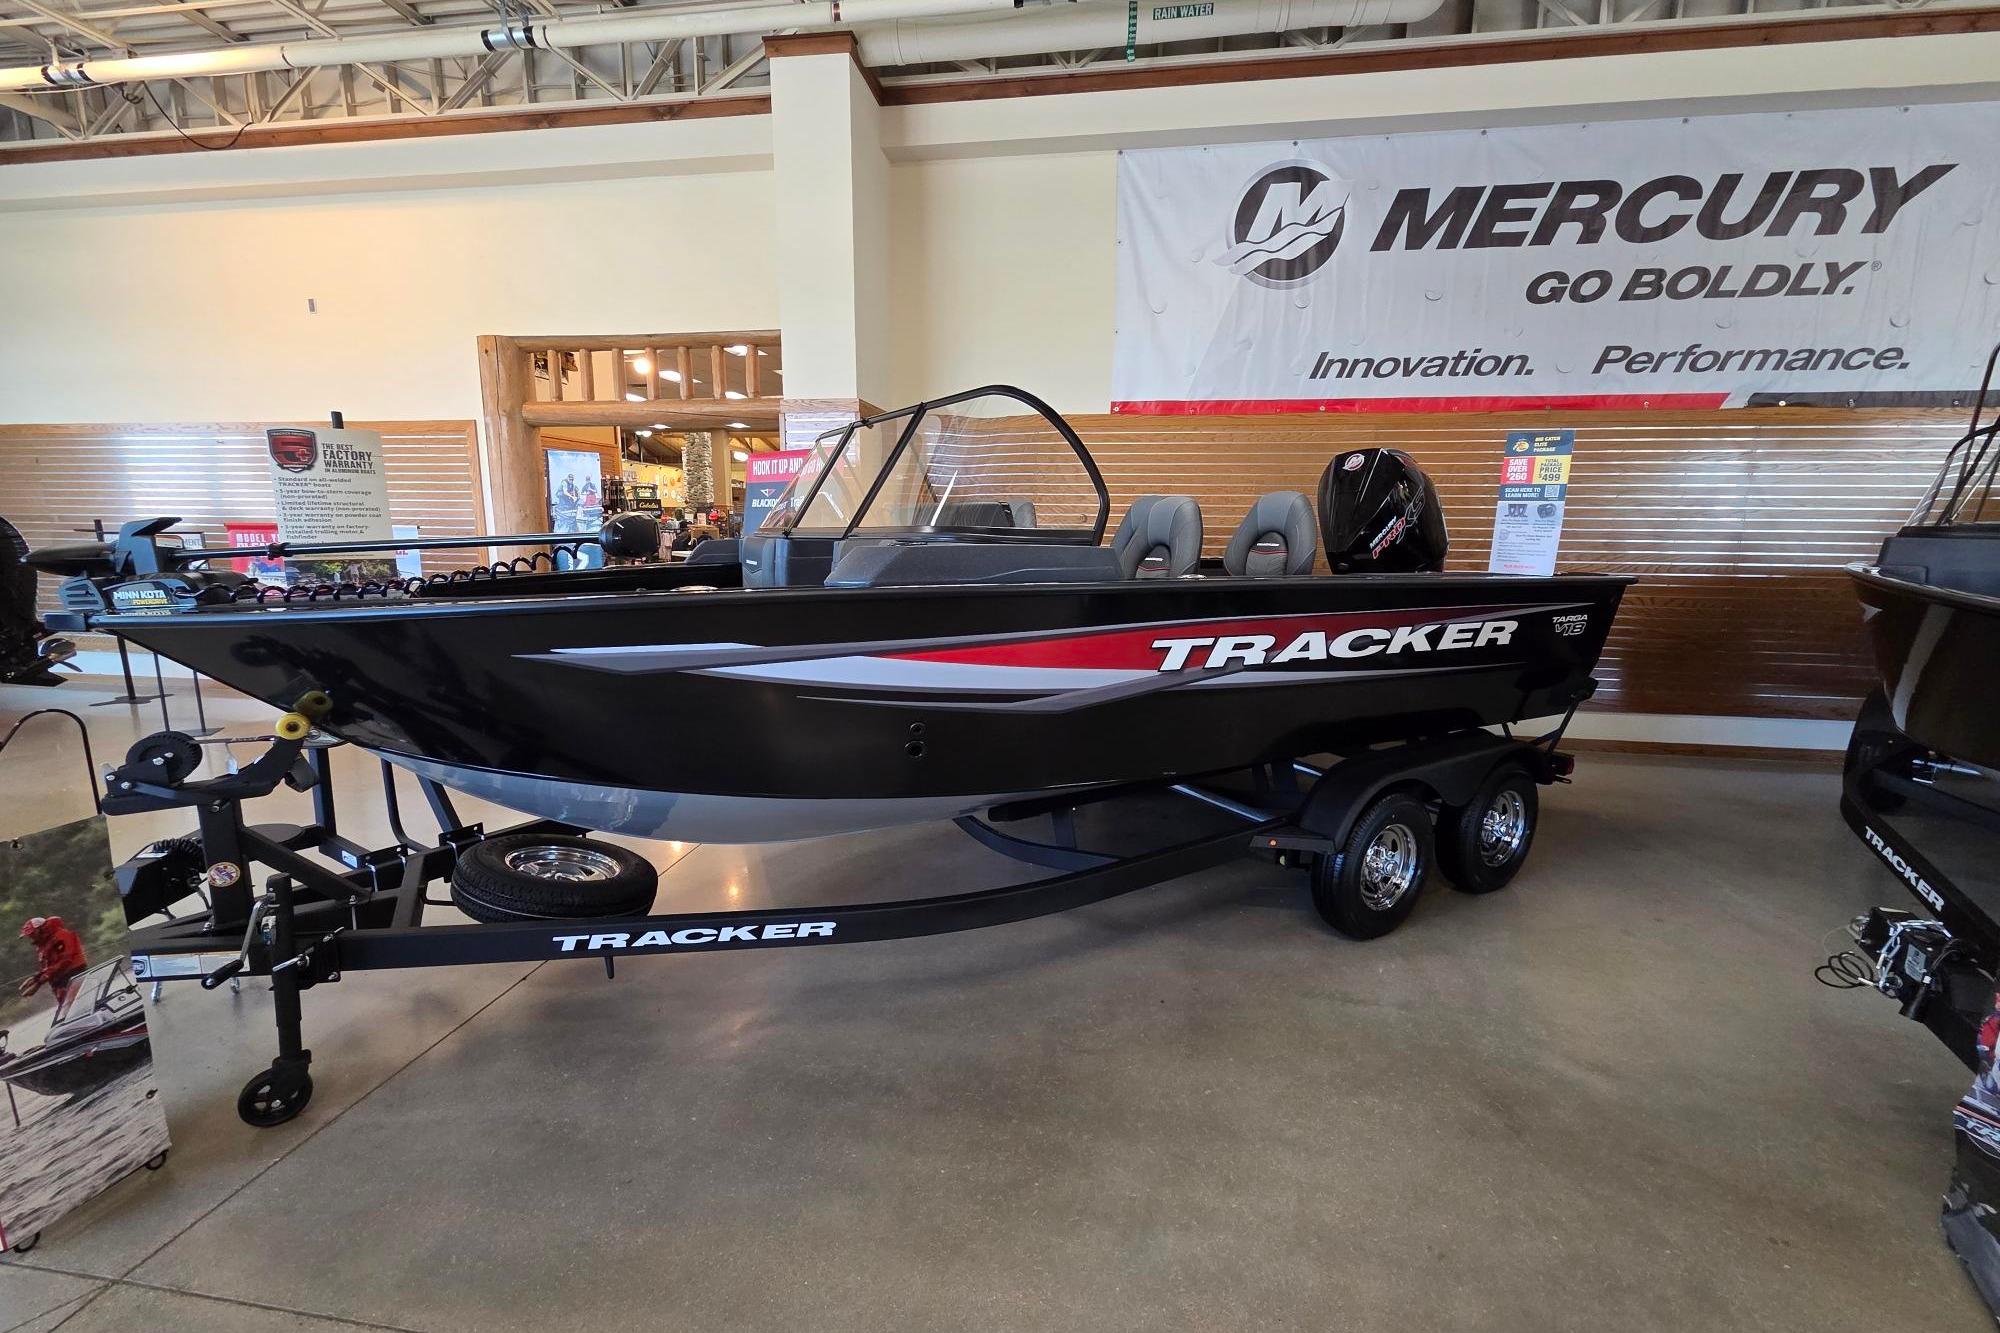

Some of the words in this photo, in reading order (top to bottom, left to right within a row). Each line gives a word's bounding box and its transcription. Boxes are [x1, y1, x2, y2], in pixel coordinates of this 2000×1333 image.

[1154, 7, 1177, 20] RAIN
[1180, 4, 1212, 18] WATER
[1369, 163, 1959, 252] MERCURY
[1525, 269, 1612, 305] GO
[1308, 348, 1534, 379] Innovation.
[1591, 343, 1910, 375] Performance.
[323, 450, 372, 461] FACTORY
[324, 460, 373, 469] WARRANTY
[753, 460, 771, 476] HOOK
[771, 460, 779, 475] IT
[780, 459, 788, 474] UP
[1538, 473, 1561, 481] $499
[236, 533, 266, 543] MODEL
[1370, 516, 1396, 550] MERCURY
[114, 590, 140, 600] MINN
[140, 589, 166, 599] KOTA
[1552, 615, 1587, 623] TARGA
[1152, 620, 1519, 672] TRACKER
[1866, 826, 1944, 912] TRACKER
[552, 922, 837, 951] TRACKER
